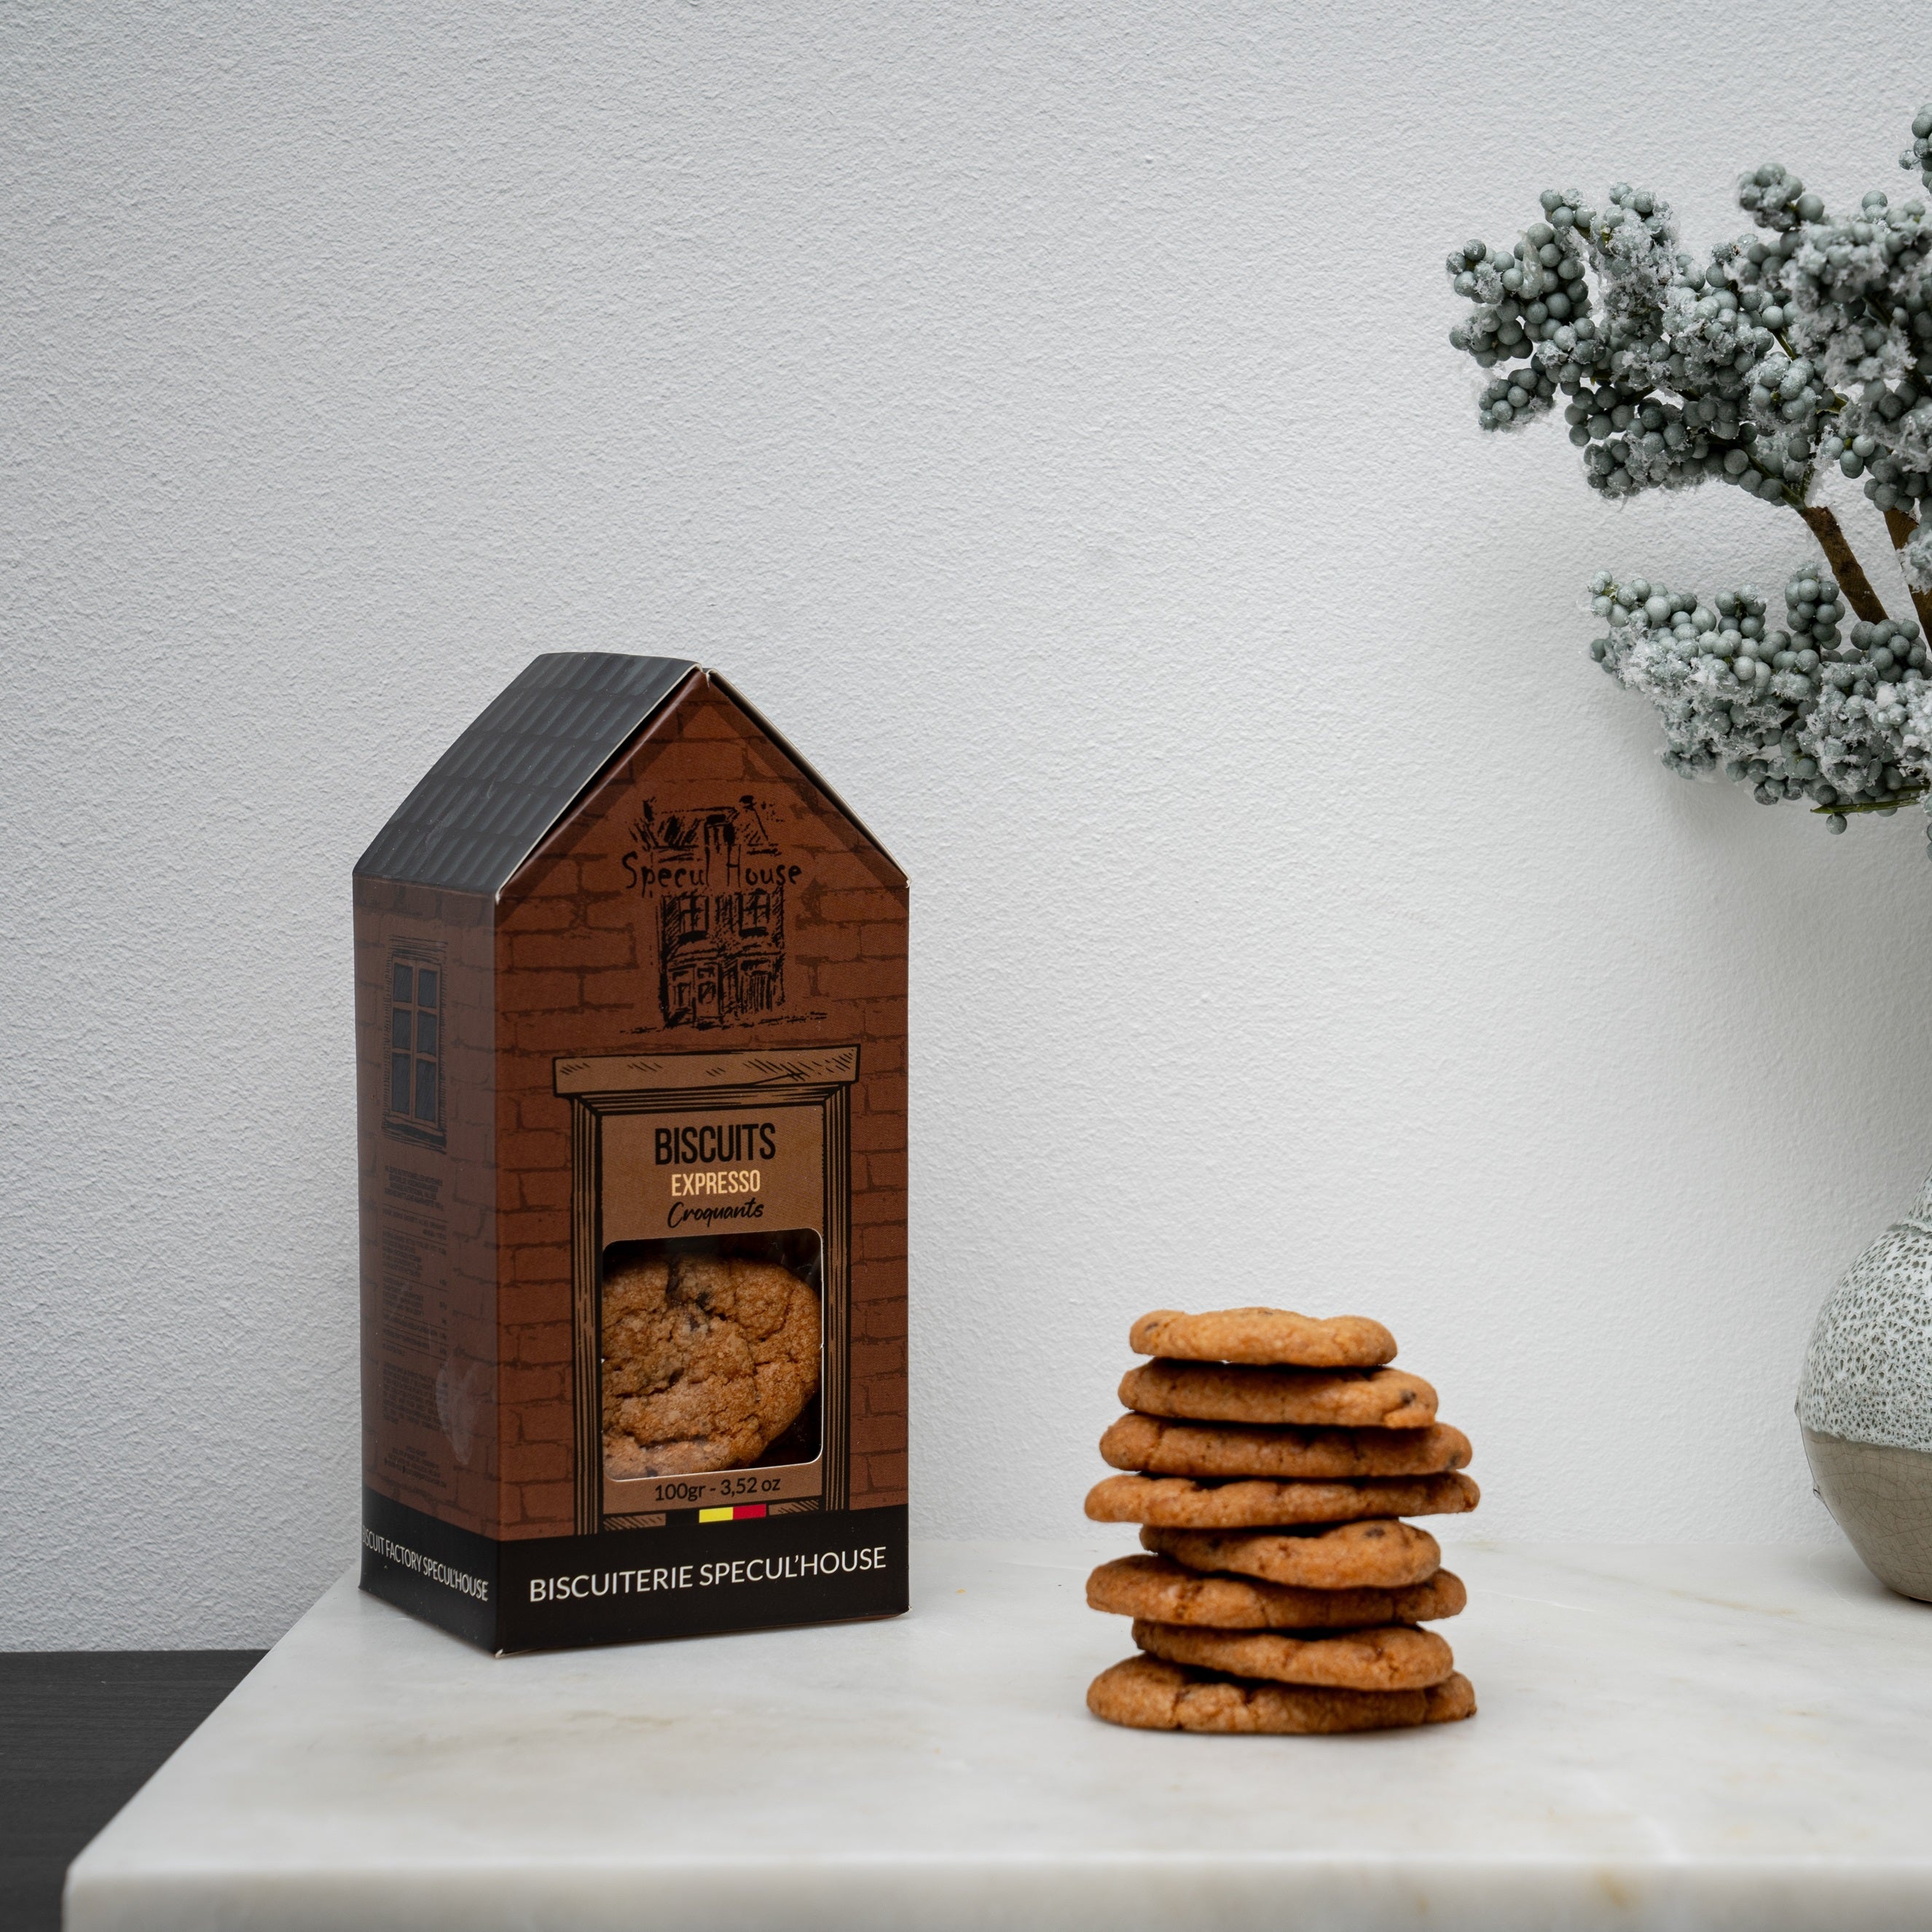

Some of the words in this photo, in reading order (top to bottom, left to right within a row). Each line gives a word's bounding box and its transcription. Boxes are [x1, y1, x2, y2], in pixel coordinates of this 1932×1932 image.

[726, 845, 801, 887] House
[655, 1123, 776, 1166] BISCUITS
[671, 1169, 761, 1196] EXPRESSO
[667, 1198, 765, 1228] Croquants
[655, 1483, 706, 1501] 100gr
[720, 1477, 758, 1497] 3,52
[761, 1478, 781, 1491] oz
[385, 1539, 423, 1572] FACTORY
[530, 1566, 693, 1602] BISCUITERIE
[699, 1547, 887, 1586] SPECUL'HOUSE
